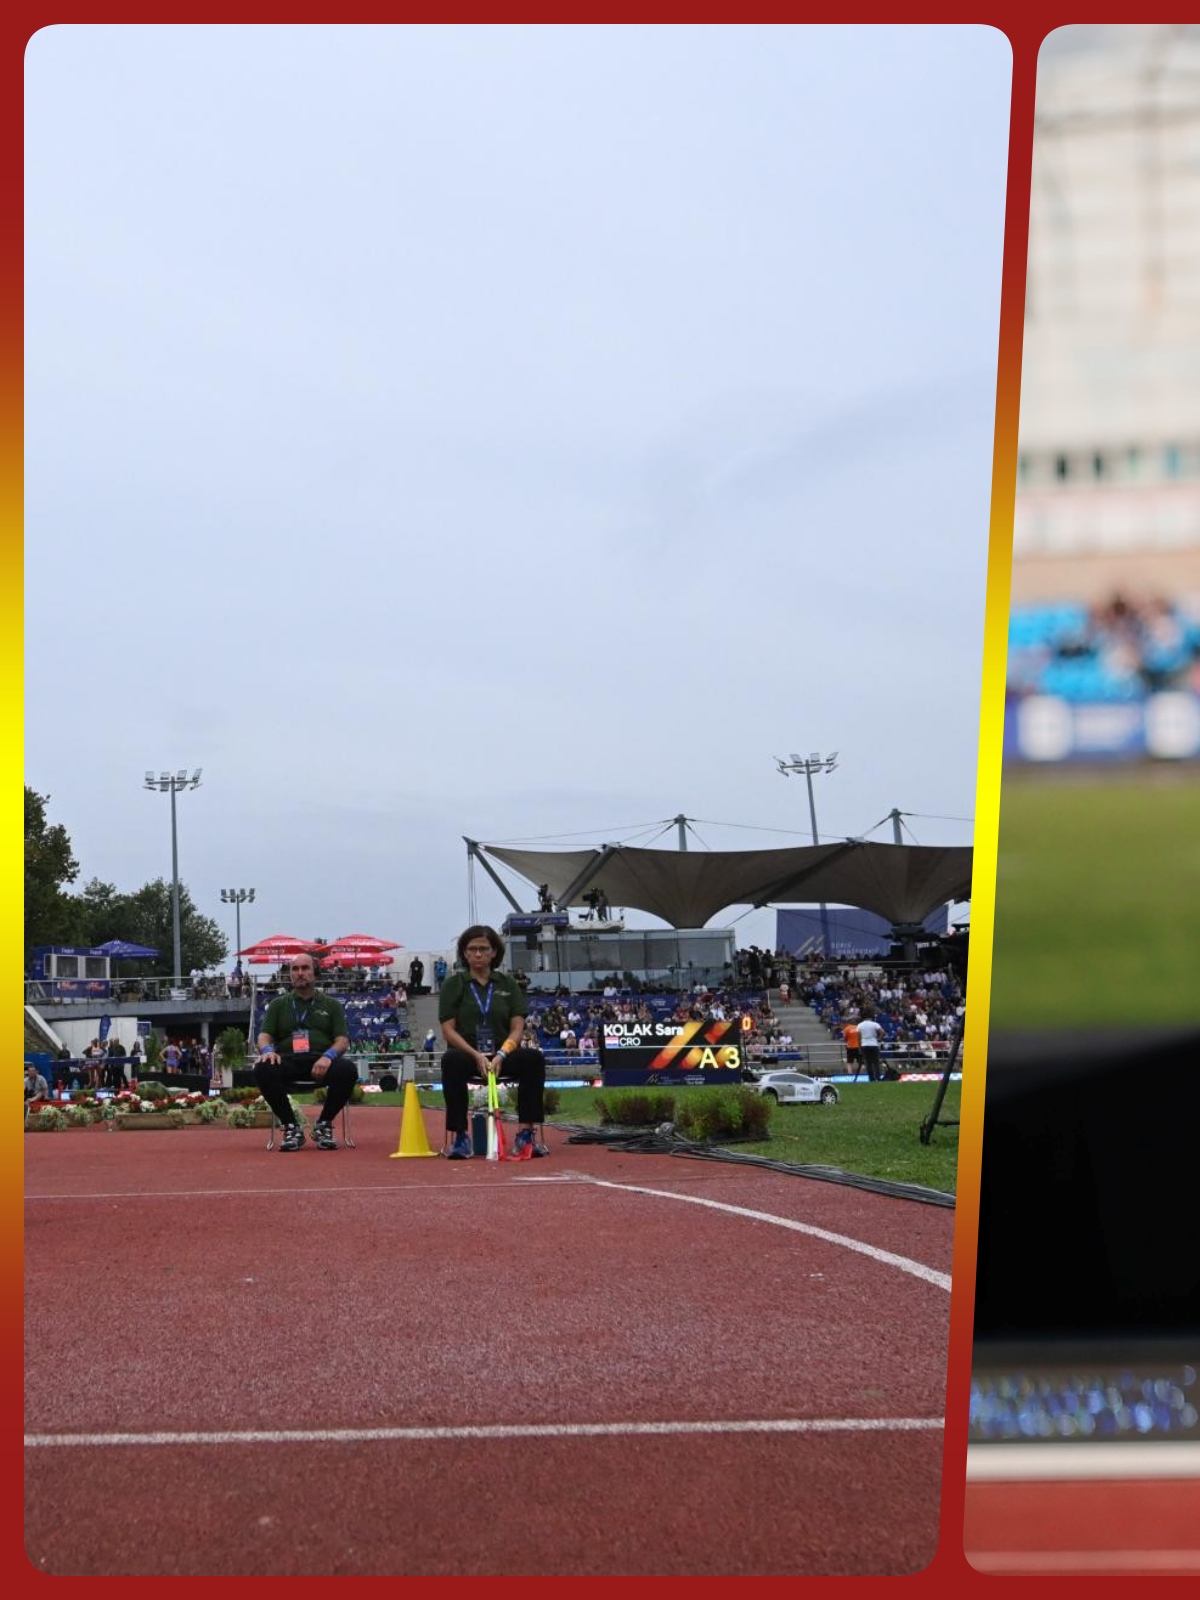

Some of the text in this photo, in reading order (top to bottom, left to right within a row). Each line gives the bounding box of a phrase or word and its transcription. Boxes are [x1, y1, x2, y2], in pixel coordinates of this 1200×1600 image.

[603, 1023, 684, 1036] KOLAK Sara
[619, 1037, 641, 1046] CRO
[699, 1046, 741, 1069] A 3
